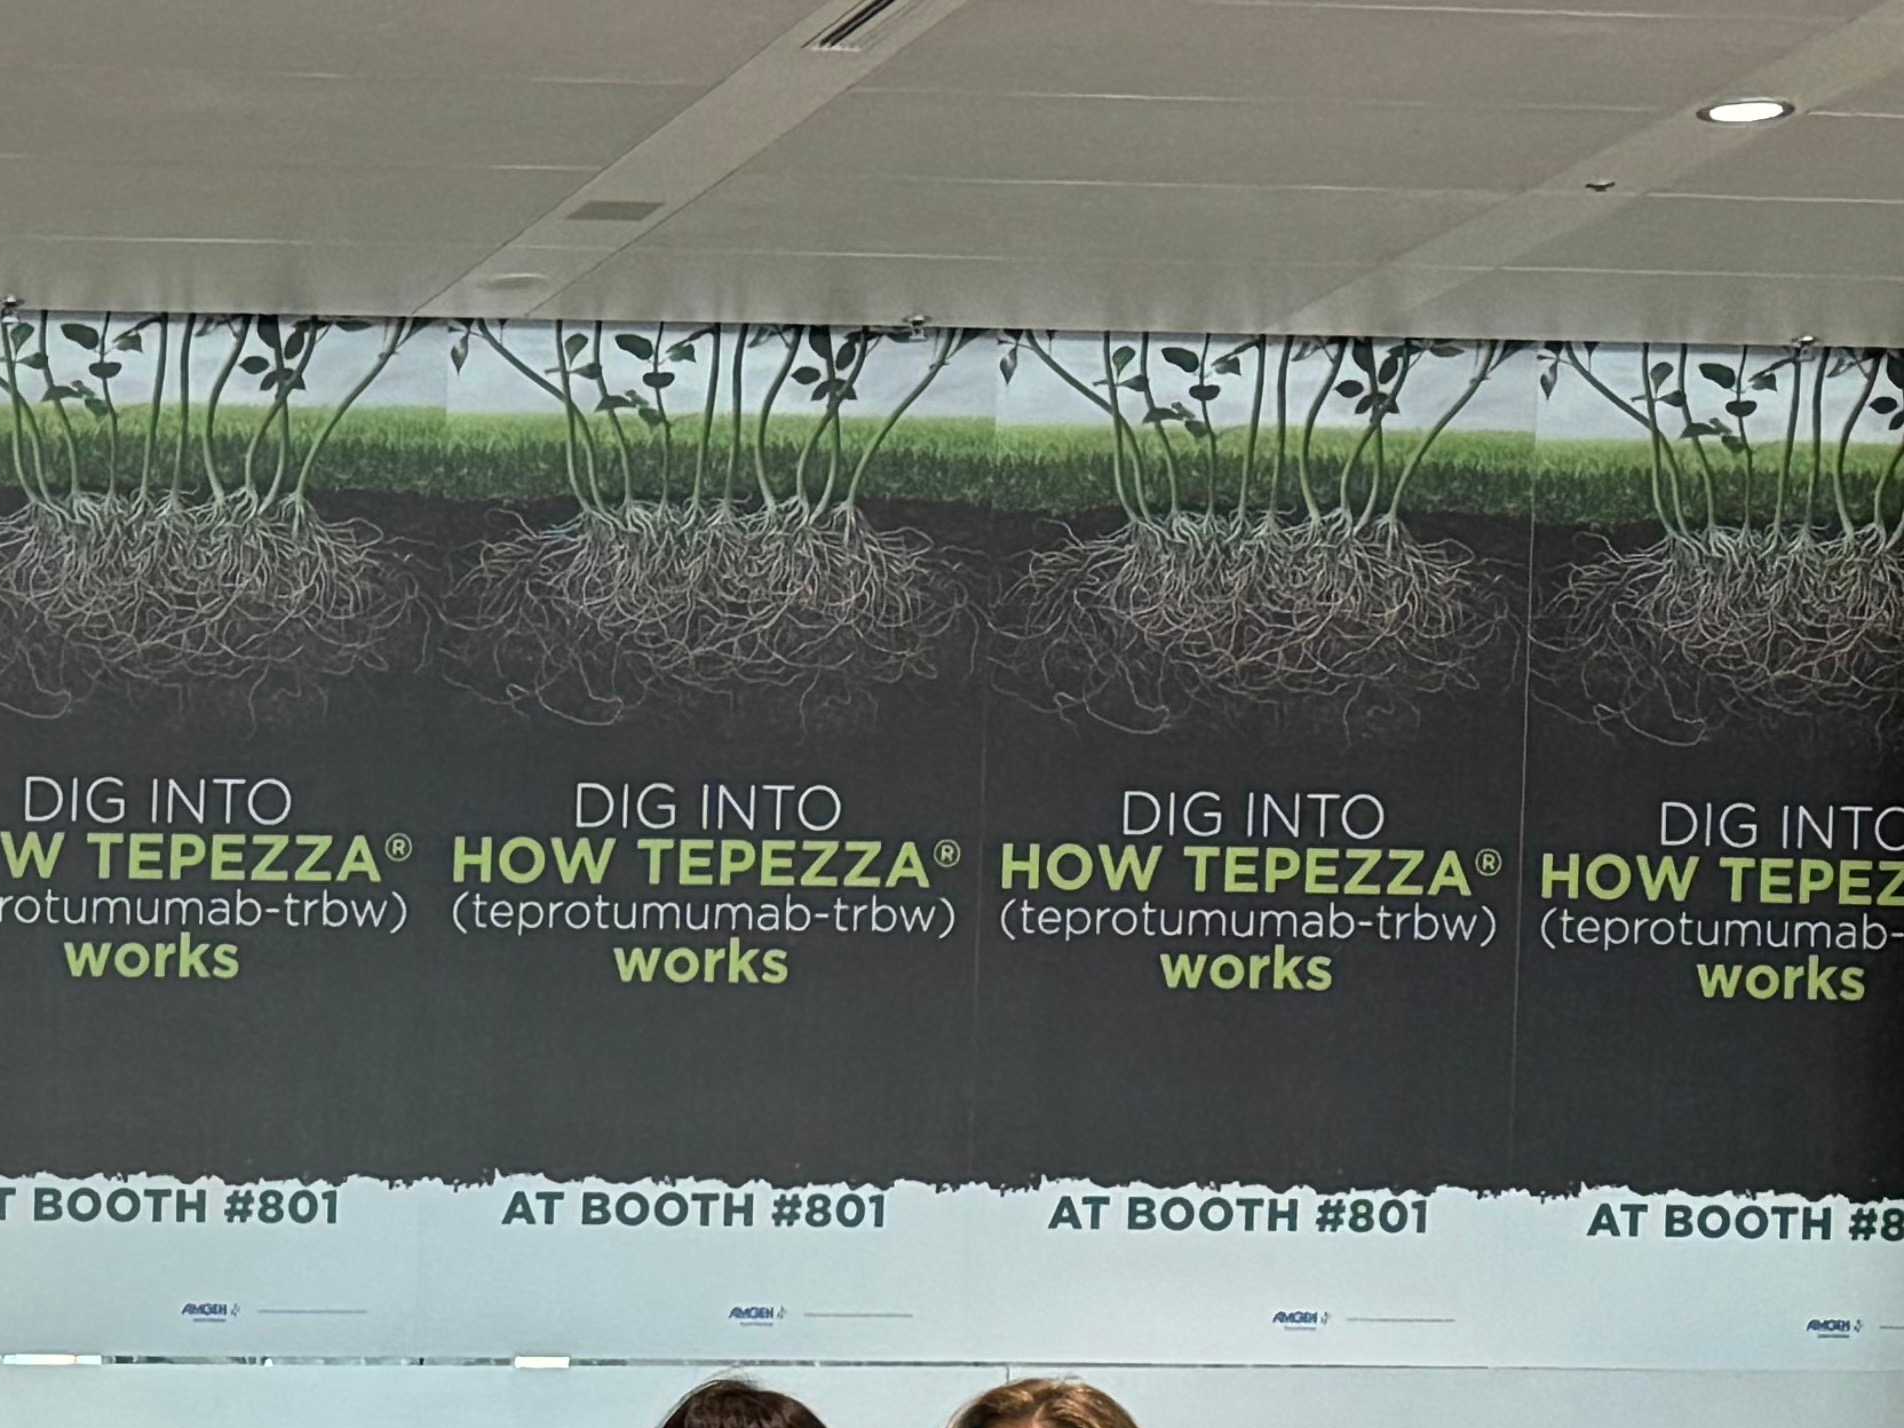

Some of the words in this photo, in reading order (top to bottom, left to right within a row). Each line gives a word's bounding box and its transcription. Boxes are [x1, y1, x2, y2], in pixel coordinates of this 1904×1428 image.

[25, 777, 125, 823] DIG
[152, 779, 291, 825] INTO
[576, 783, 675, 829] DIG
[703, 784, 841, 831] INTO
[1124, 791, 1221, 836] DIG
[1248, 793, 1384, 839] INTO
[1661, 802, 1757, 848] DIG
[1783, 806, 1904, 851] INTO
[454, 837, 616, 884] HOW
[1002, 843, 1162, 891] HOW
[1542, 854, 1699, 901] HOW
[453, 889, 954, 938] (teprotumumab-trbw)
[1001, 896, 1495, 946] (teprotumumab-trbw)
[64, 932, 238, 978] works
[614, 937, 787, 983] works
[1160, 944, 1331, 990] works
[1697, 955, 1864, 1000] works
[34, 1187, 207, 1223] BOOTH
[224, 1190, 338, 1224] #801
[502, 1191, 564, 1225] AT
[582, 1192, 753, 1227] BOOTH
[772, 1194, 885, 1228] #801
[1048, 1196, 1110, 1230] AT
[1128, 1197, 1297, 1232] BOOTH
[1316, 1199, 1428, 1234] #801
[1587, 1204, 1648, 1237] AT
[1665, 1205, 1832, 1241] BOOTH
[182, 1303, 227, 1315] AMGEN
